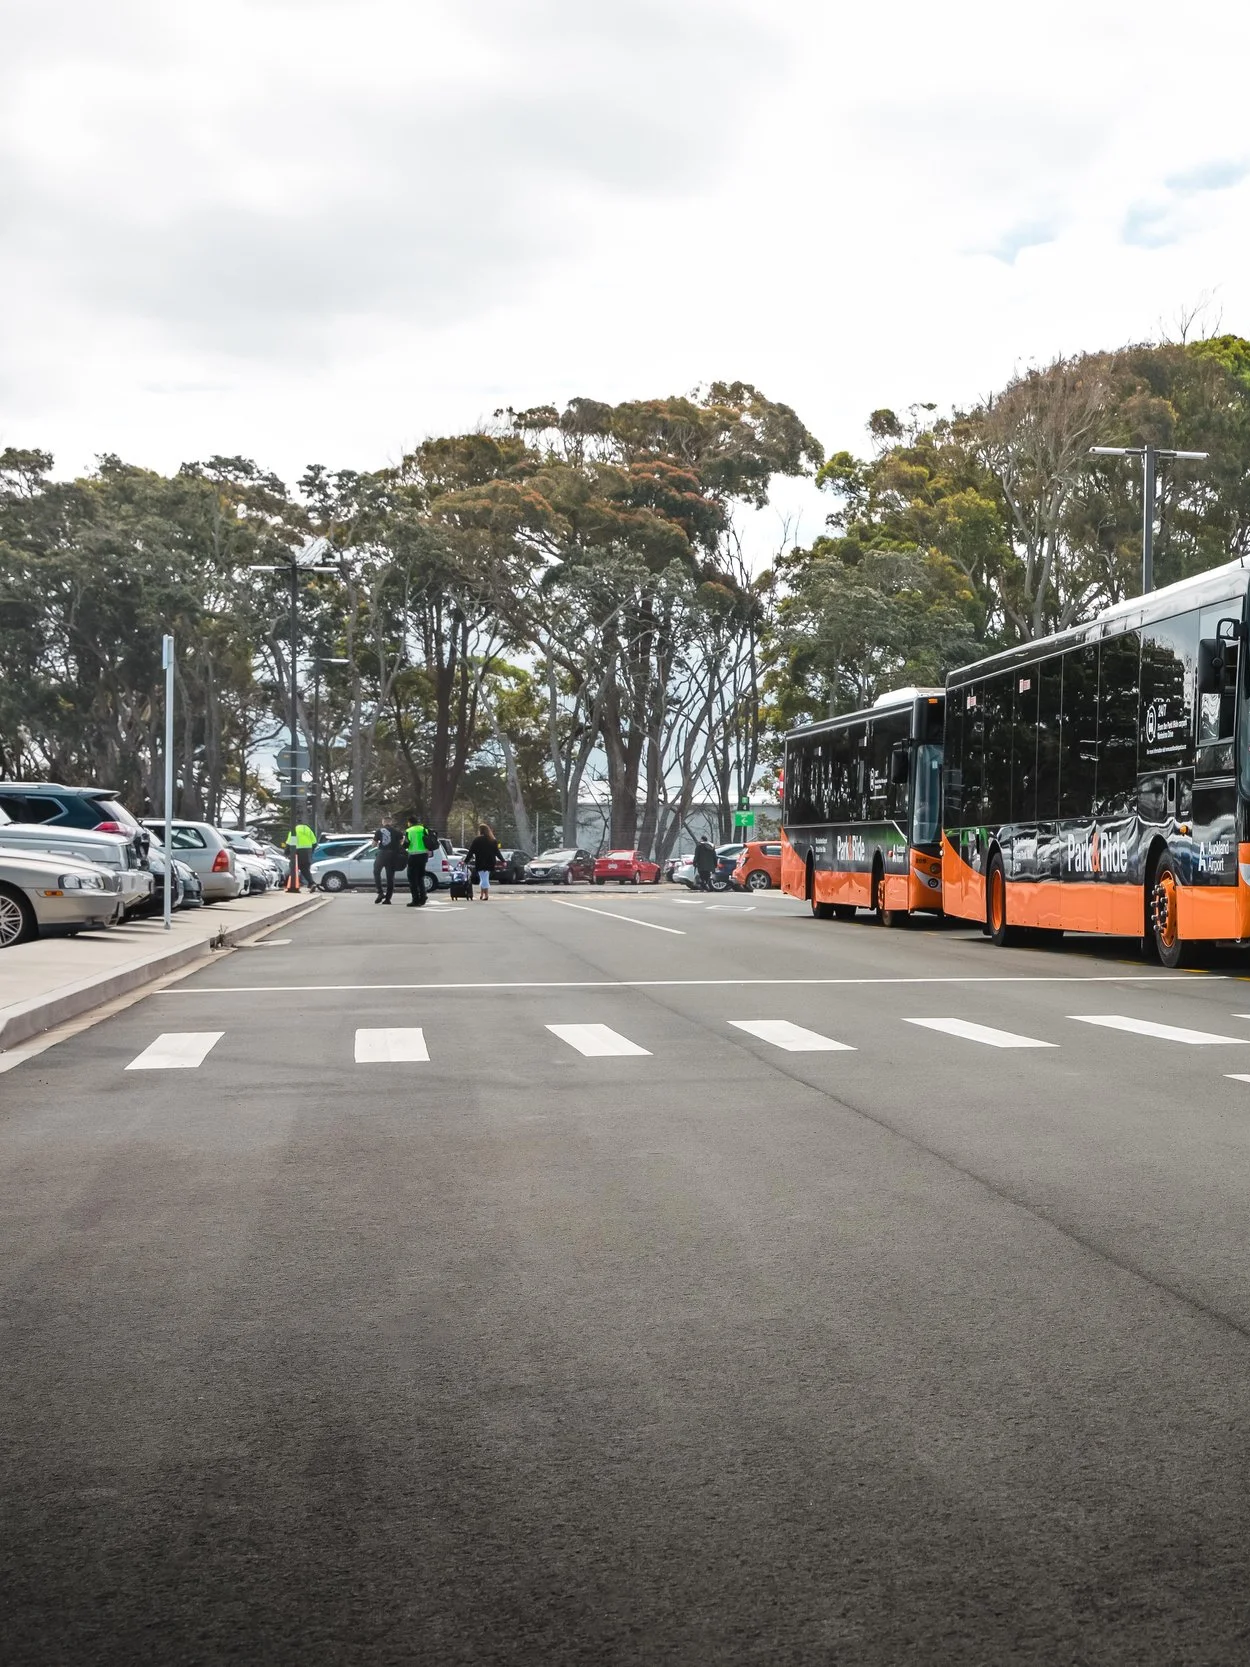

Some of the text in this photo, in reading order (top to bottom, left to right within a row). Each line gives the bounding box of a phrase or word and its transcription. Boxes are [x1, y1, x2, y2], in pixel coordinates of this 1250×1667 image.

[1068, 832, 1127, 872] Park&Ride
[1208, 840, 1230, 855] Auckland
[1208, 856, 1225, 874] Airport
